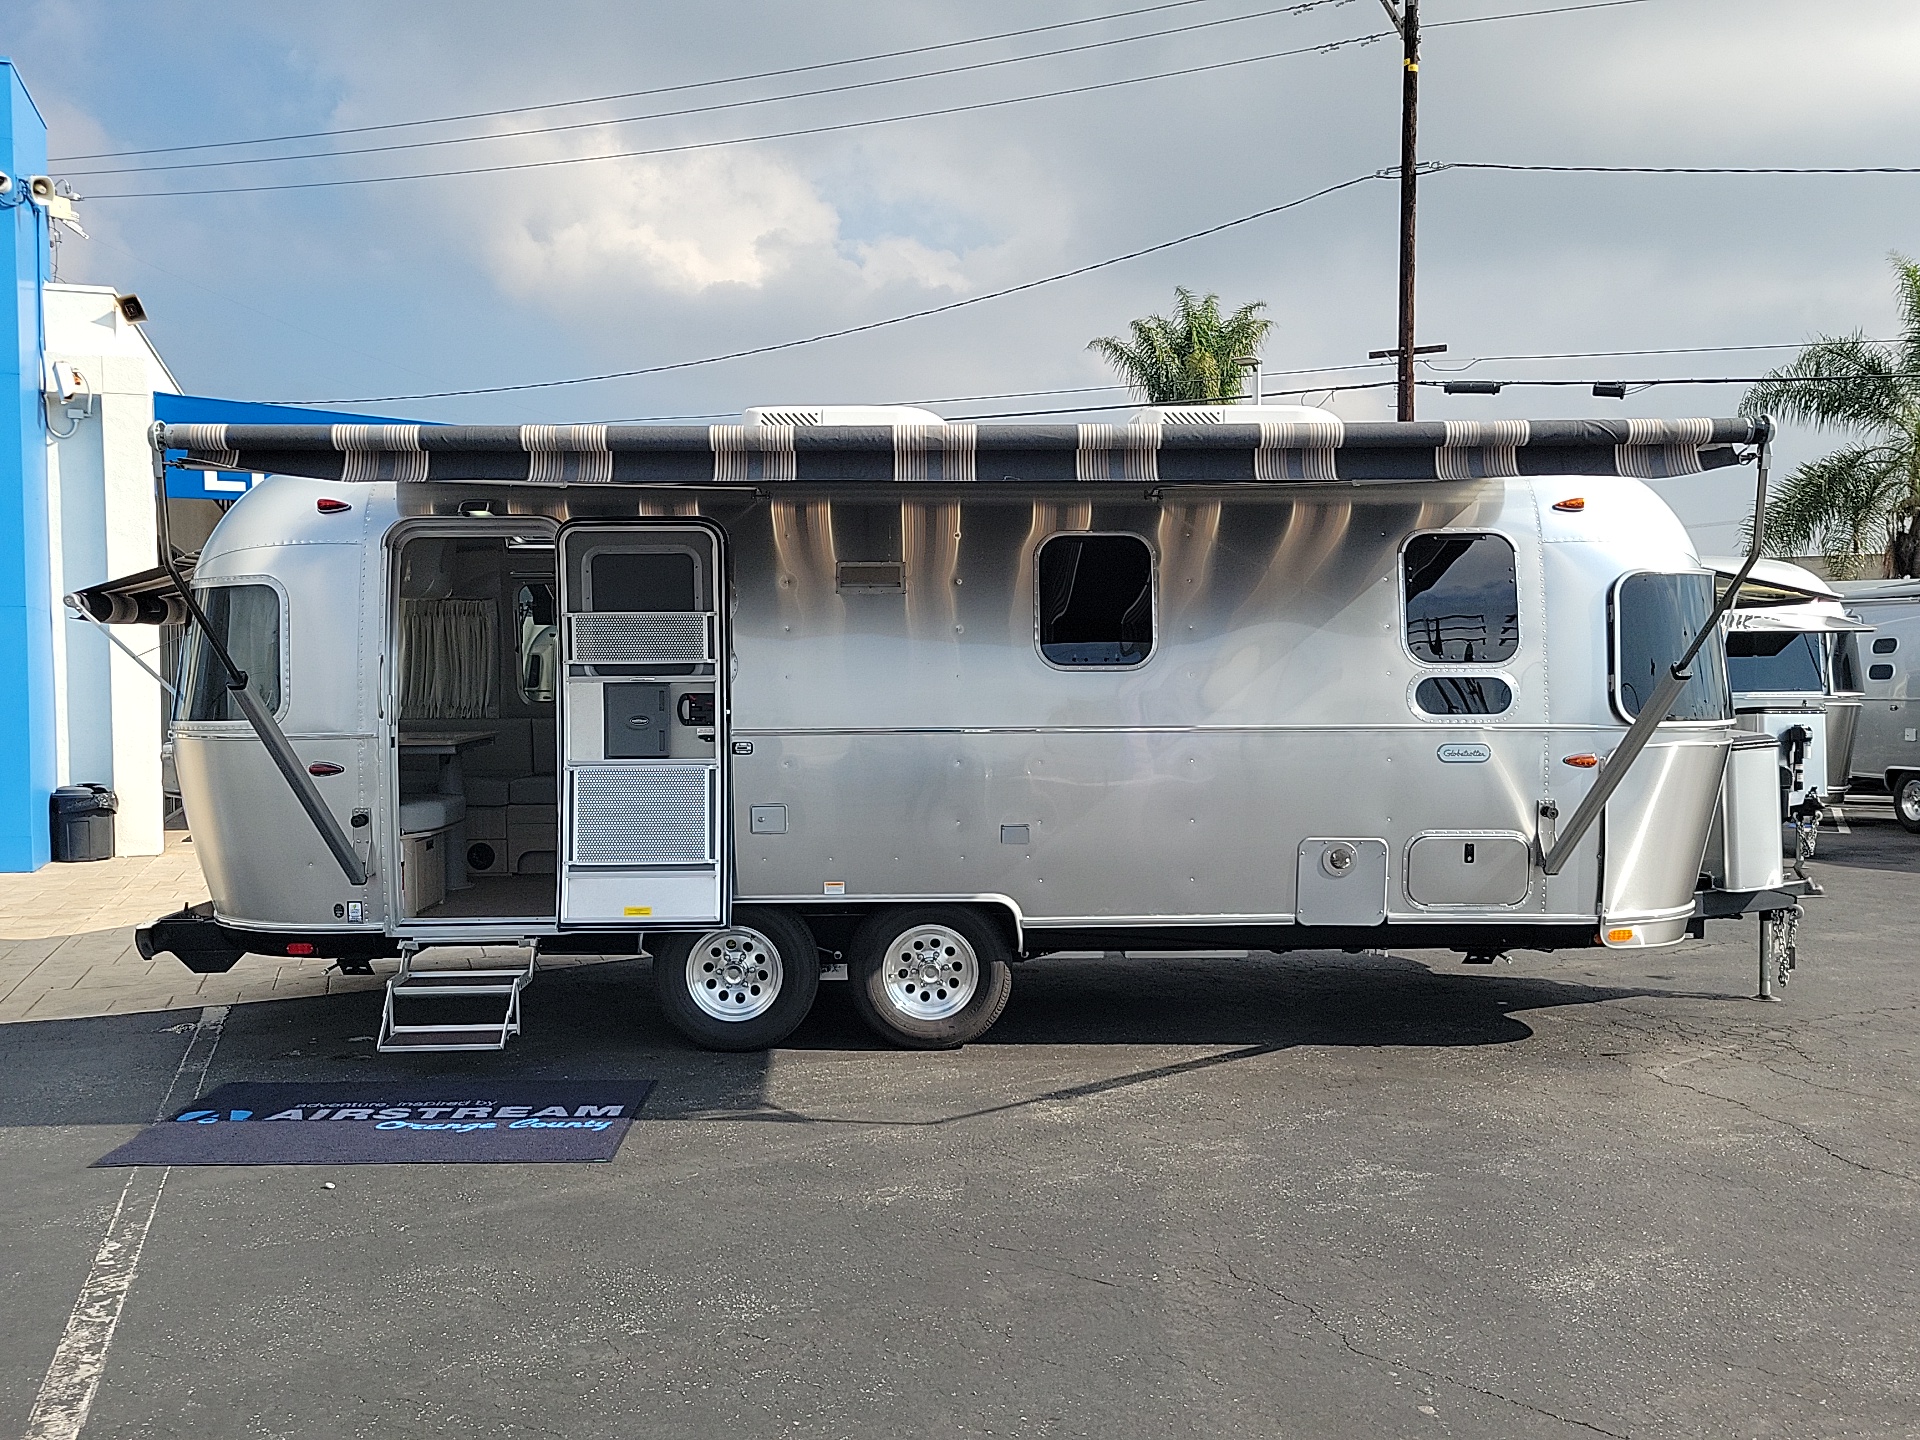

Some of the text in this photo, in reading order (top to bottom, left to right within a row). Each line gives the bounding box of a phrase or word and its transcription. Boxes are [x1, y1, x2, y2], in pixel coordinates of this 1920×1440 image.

[1443, 748, 1486, 757] Globetrotter
[263, 1105, 625, 1121] AIRSTREAM
[375, 1118, 613, 1133] Orange County
